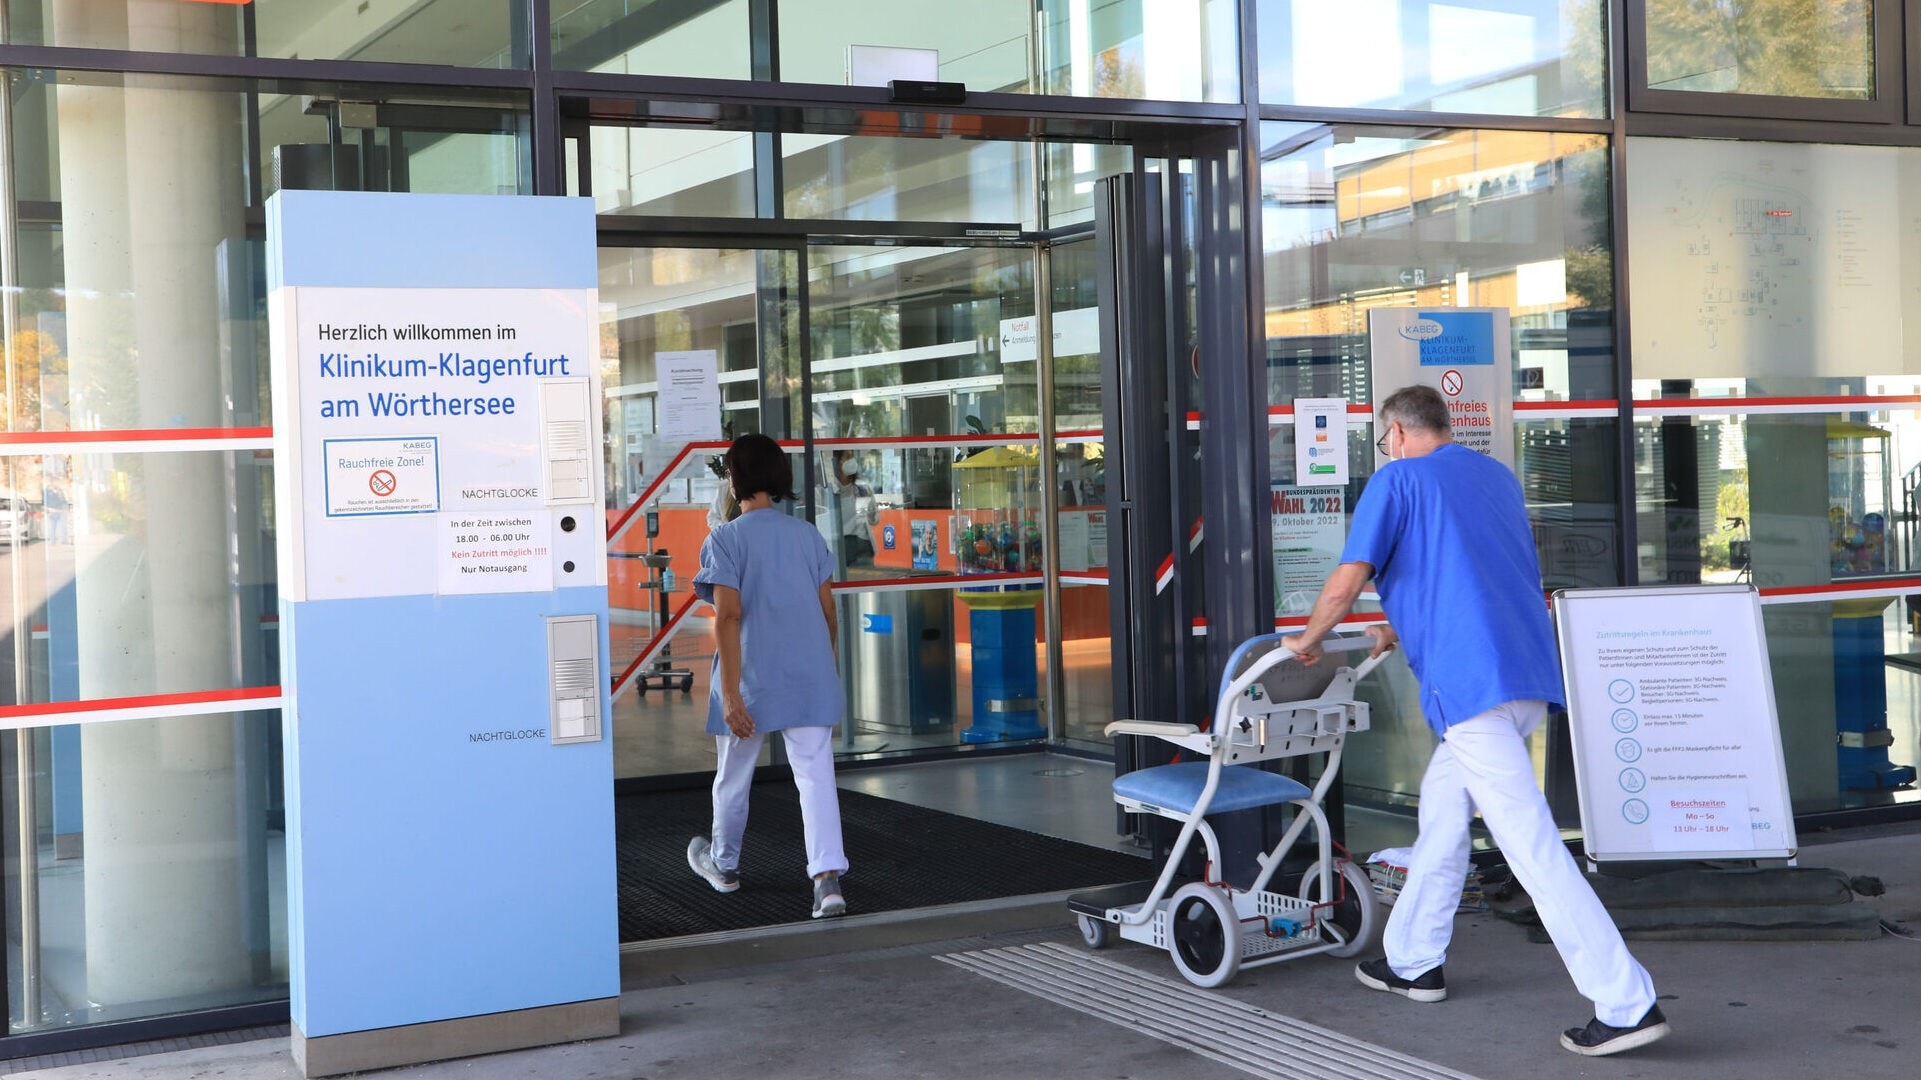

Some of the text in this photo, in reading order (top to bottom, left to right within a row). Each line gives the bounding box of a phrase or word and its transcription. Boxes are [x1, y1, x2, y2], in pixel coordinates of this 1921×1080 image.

[318, 324, 516, 341] Herzlich willkommen im
[1405, 325, 1439, 334] KABEG
[1421, 345, 1476, 354] KLAGENFURT
[320, 352, 570, 384] Klinikum-Klagenfurt
[321, 392, 515, 417] am Wörthersee
[1447, 400, 1487, 412] hfreies
[1450, 415, 1492, 427] enhaus
[339, 456, 425, 469] Rauchfreie Zone!
[462, 488, 538, 499] NACHTGLOCKE
[1286, 488, 1341, 496] BUNDESPRÄSIDENTEN
[1270, 490, 1341, 515] WAHL 2022
[450, 518, 532, 528] In der Zeit zwischen
[1282, 517, 1314, 526] Oktober
[1317, 516, 1338, 526] 2022
[456, 535, 479, 543] 18.00
[490, 533, 513, 542] 06.00
[515, 533, 530, 541] Uhr
[452, 547, 547, 559] Kein Zutritt möglich !!!!
[461, 564, 528, 574] Nur Notausgang
[469, 729, 546, 742] NACHTGLOCKE
[1670, 799, 1726, 808] Besuchszeiten
[1751, 822, 1771, 830] BEG
